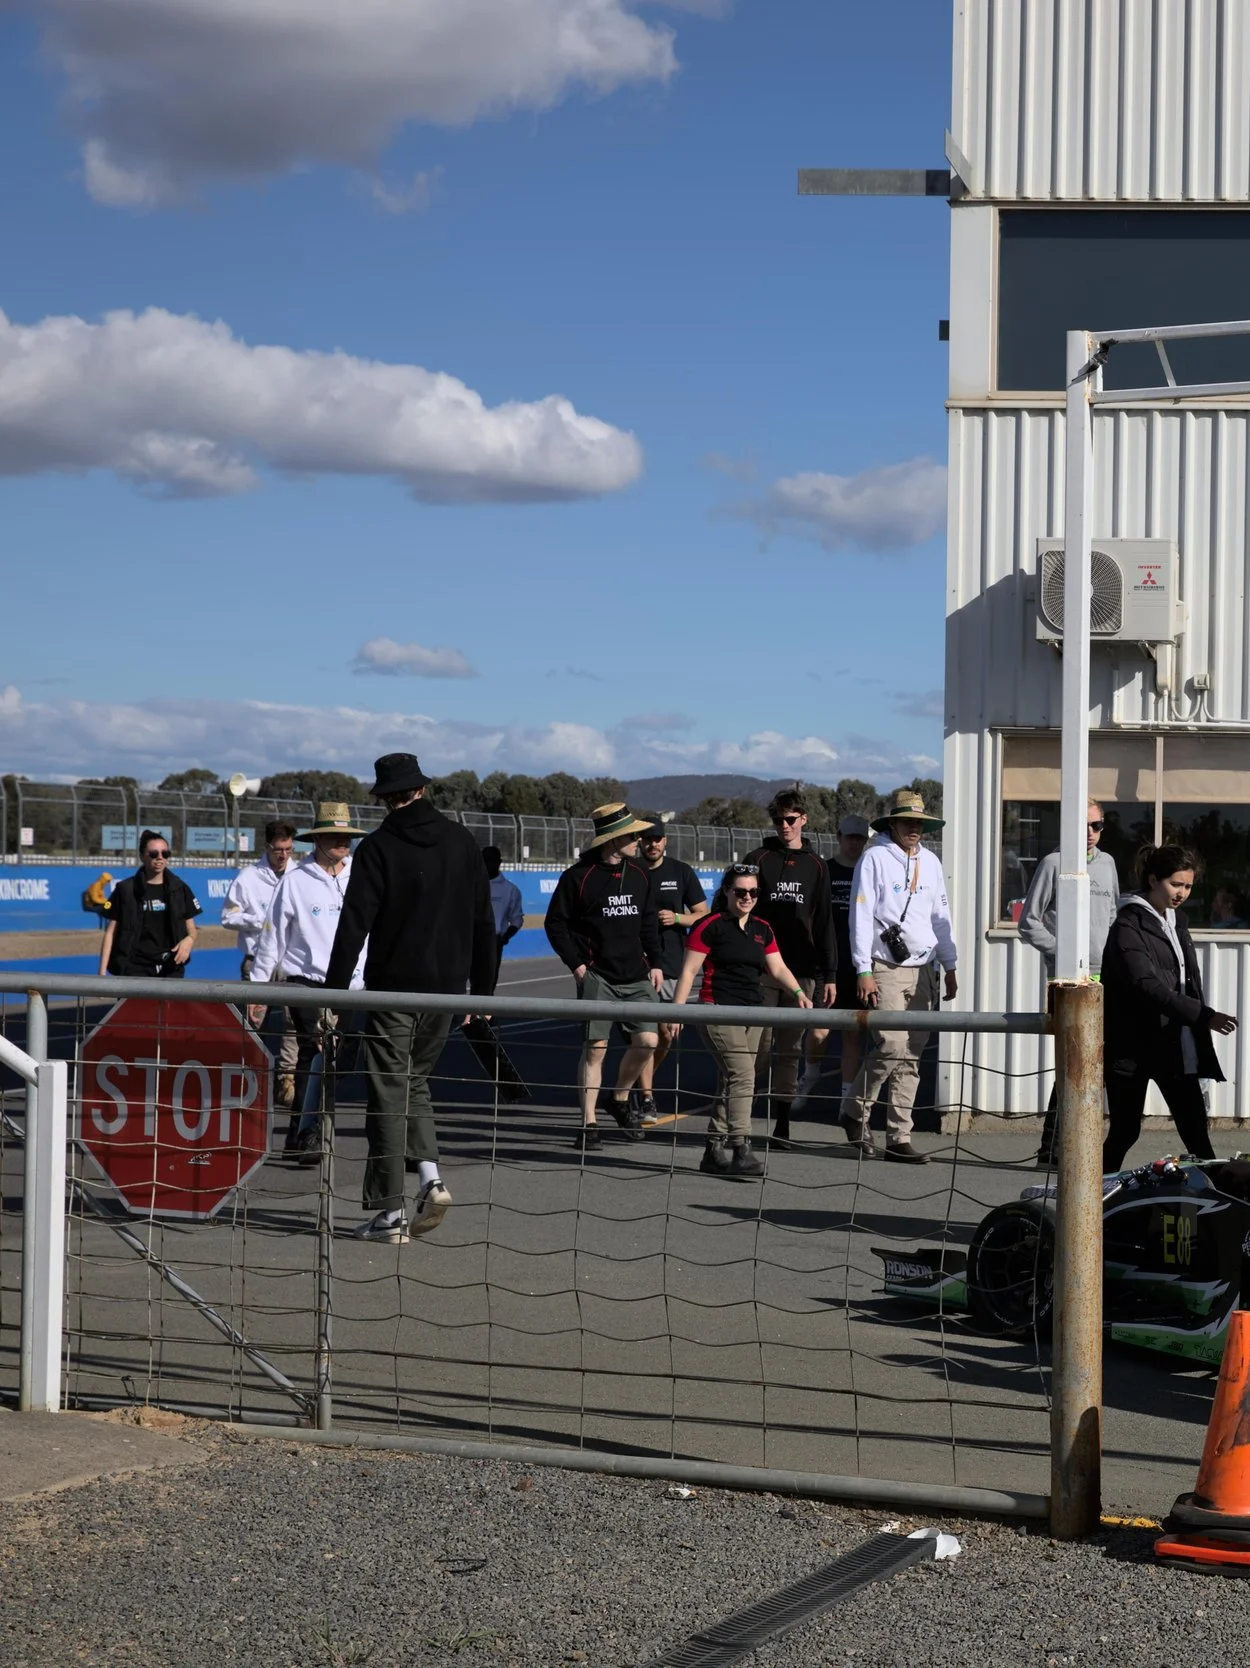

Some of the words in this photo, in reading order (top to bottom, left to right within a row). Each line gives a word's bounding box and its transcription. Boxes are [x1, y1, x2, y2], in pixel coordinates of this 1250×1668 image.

[776, 881, 802, 892] RMIT
[608, 894, 633, 906] RMIT
[770, 892, 804, 904] RACING
[602, 905, 639, 917] RACING
[91, 1054, 259, 1143] STOP
[1163, 1214, 1192, 1267] E88
[886, 1260, 934, 1278] RONSON
